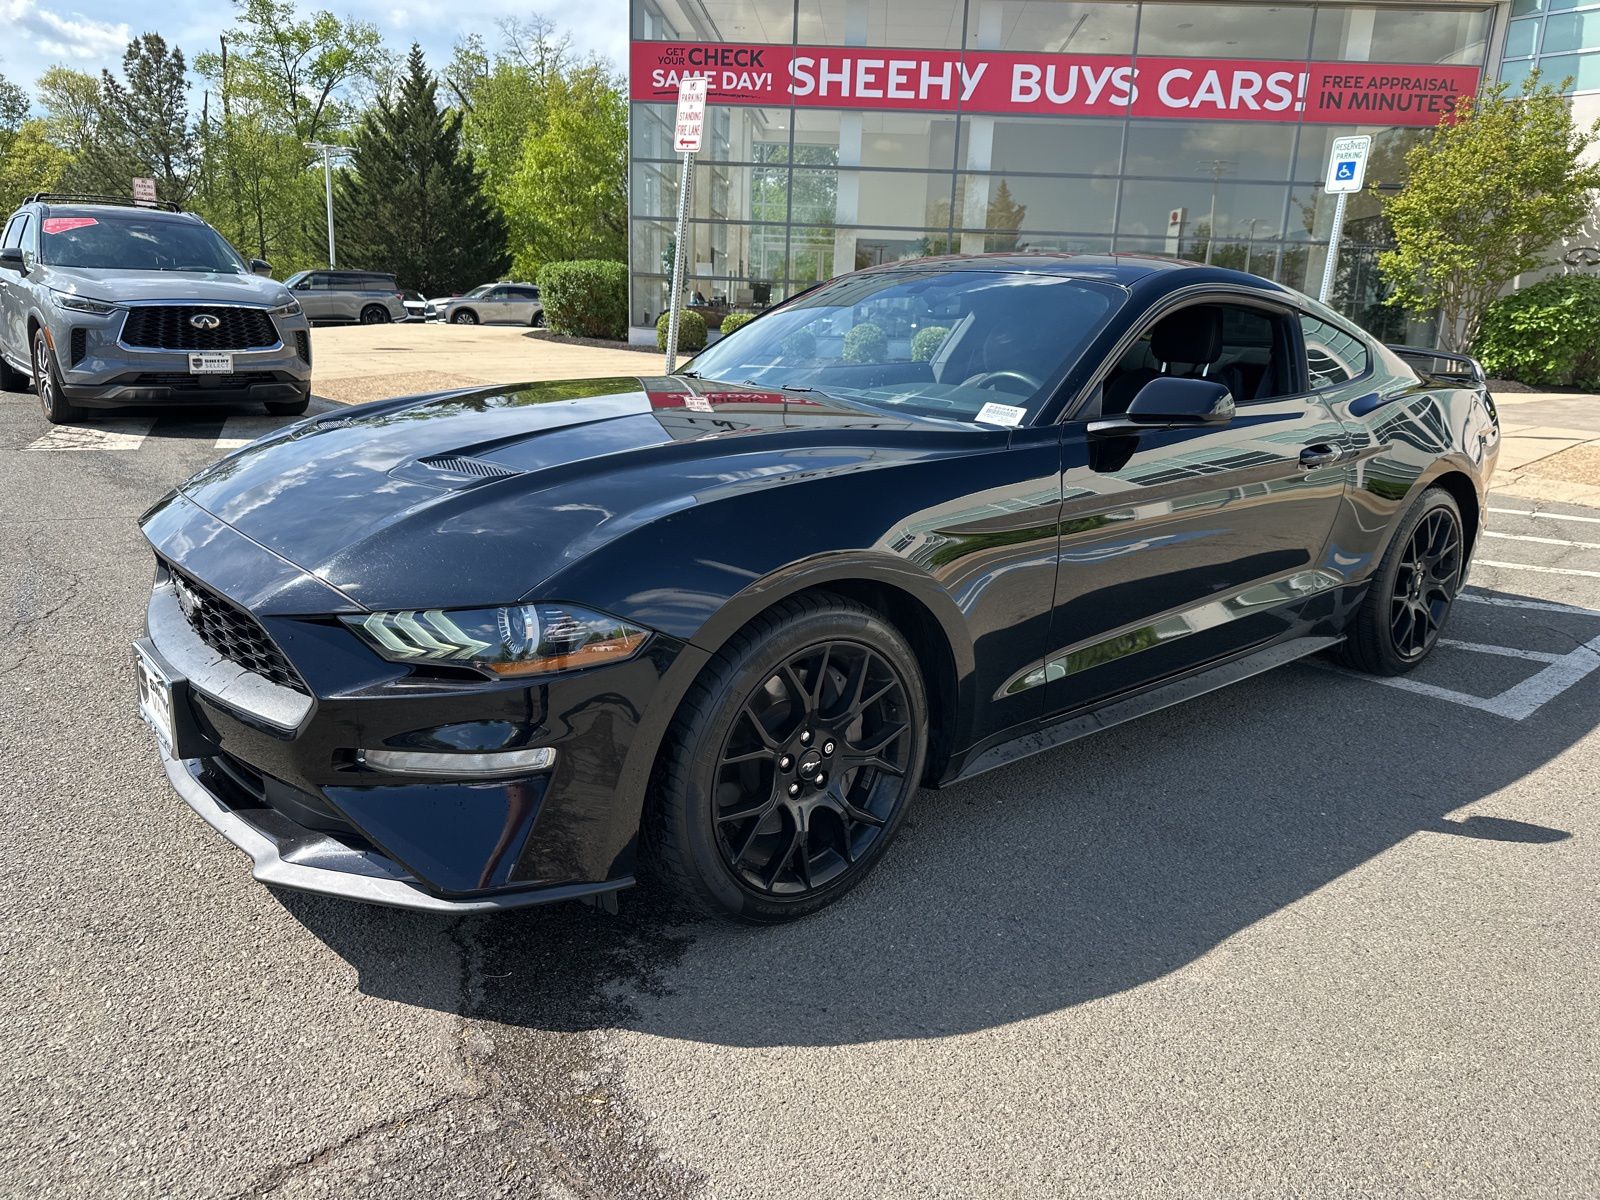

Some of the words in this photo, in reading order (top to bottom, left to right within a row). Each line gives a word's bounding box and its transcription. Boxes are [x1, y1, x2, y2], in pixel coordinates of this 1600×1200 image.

[665, 47, 686, 56] GET
[658, 56, 686, 65] YOUR
[688, 48, 765, 68] CHECK
[689, 81, 697, 91] NO
[722, 71, 773, 91] DAY!
[787, 57, 988, 100] SHEEHY
[1010, 63, 1140, 107] BUYS
[1157, 68, 1311, 112] CARS!
[1321, 75, 1365, 89] FREE
[1367, 76, 1459, 92] APPRAISAL
[681, 92, 703, 103] PARKING
[1319, 91, 1343, 110] IN
[1347, 92, 1457, 113] MINUTES
[679, 111, 702, 121] STANDING
[677, 124, 688, 136] FIRE
[688, 124, 701, 136] LANE
[1336, 141, 1367, 150] RESERVED
[1336, 151, 1363, 160] PARKING
